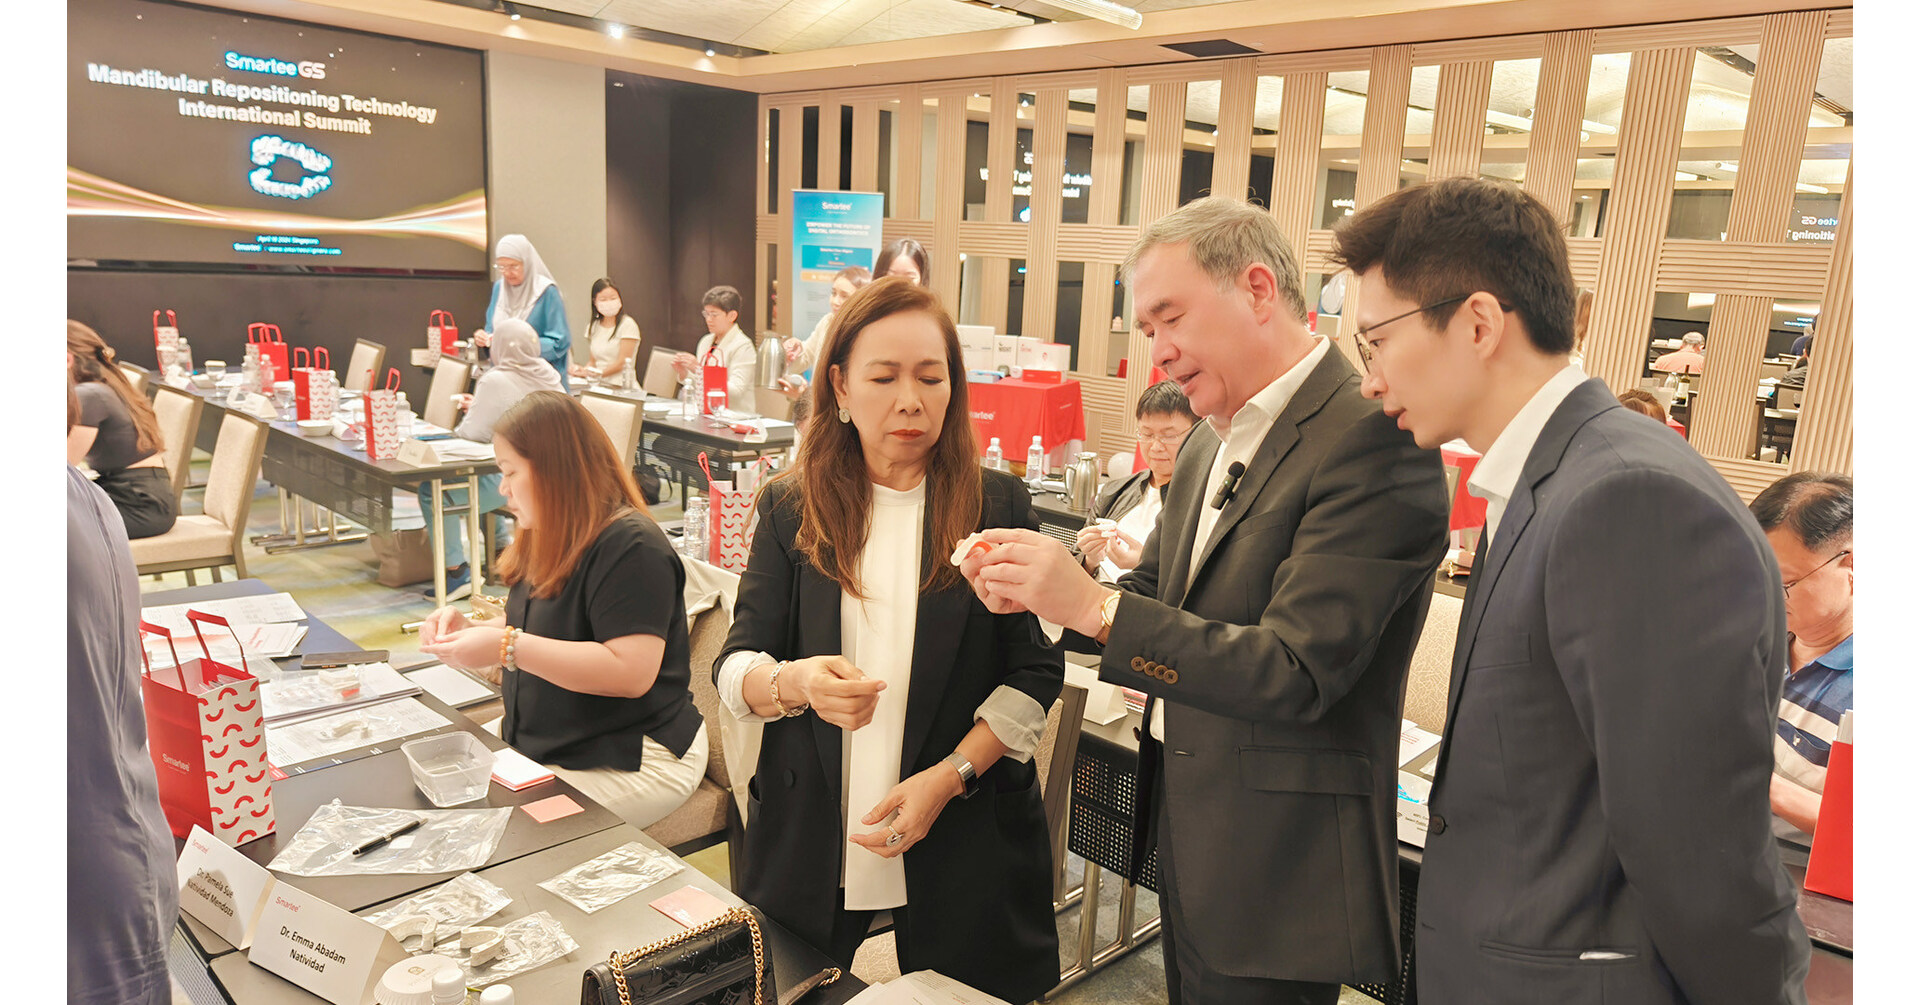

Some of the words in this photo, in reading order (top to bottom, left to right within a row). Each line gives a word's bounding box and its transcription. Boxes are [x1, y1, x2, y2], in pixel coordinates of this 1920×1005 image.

[225, 50, 298, 77] Smartee
[298, 60, 326, 79] GS
[87, 62, 209, 95] Mandibular
[211, 78, 340, 113] Repositioning
[341, 93, 438, 125] Technology
[178, 97, 301, 127] International
[302, 111, 372, 135] Summit
[162, 753, 190, 772] Smartee
[205, 872, 223, 892] Pamela
[223, 885, 234, 899] Sue
[210, 894, 234, 917] Mendoza
[275, 896, 300, 913] Smartee
[280, 925, 290, 938] Dr.
[291, 931, 314, 950] Emma
[314, 943, 346, 965] Abadam
[289, 948, 325, 973] Natividad
